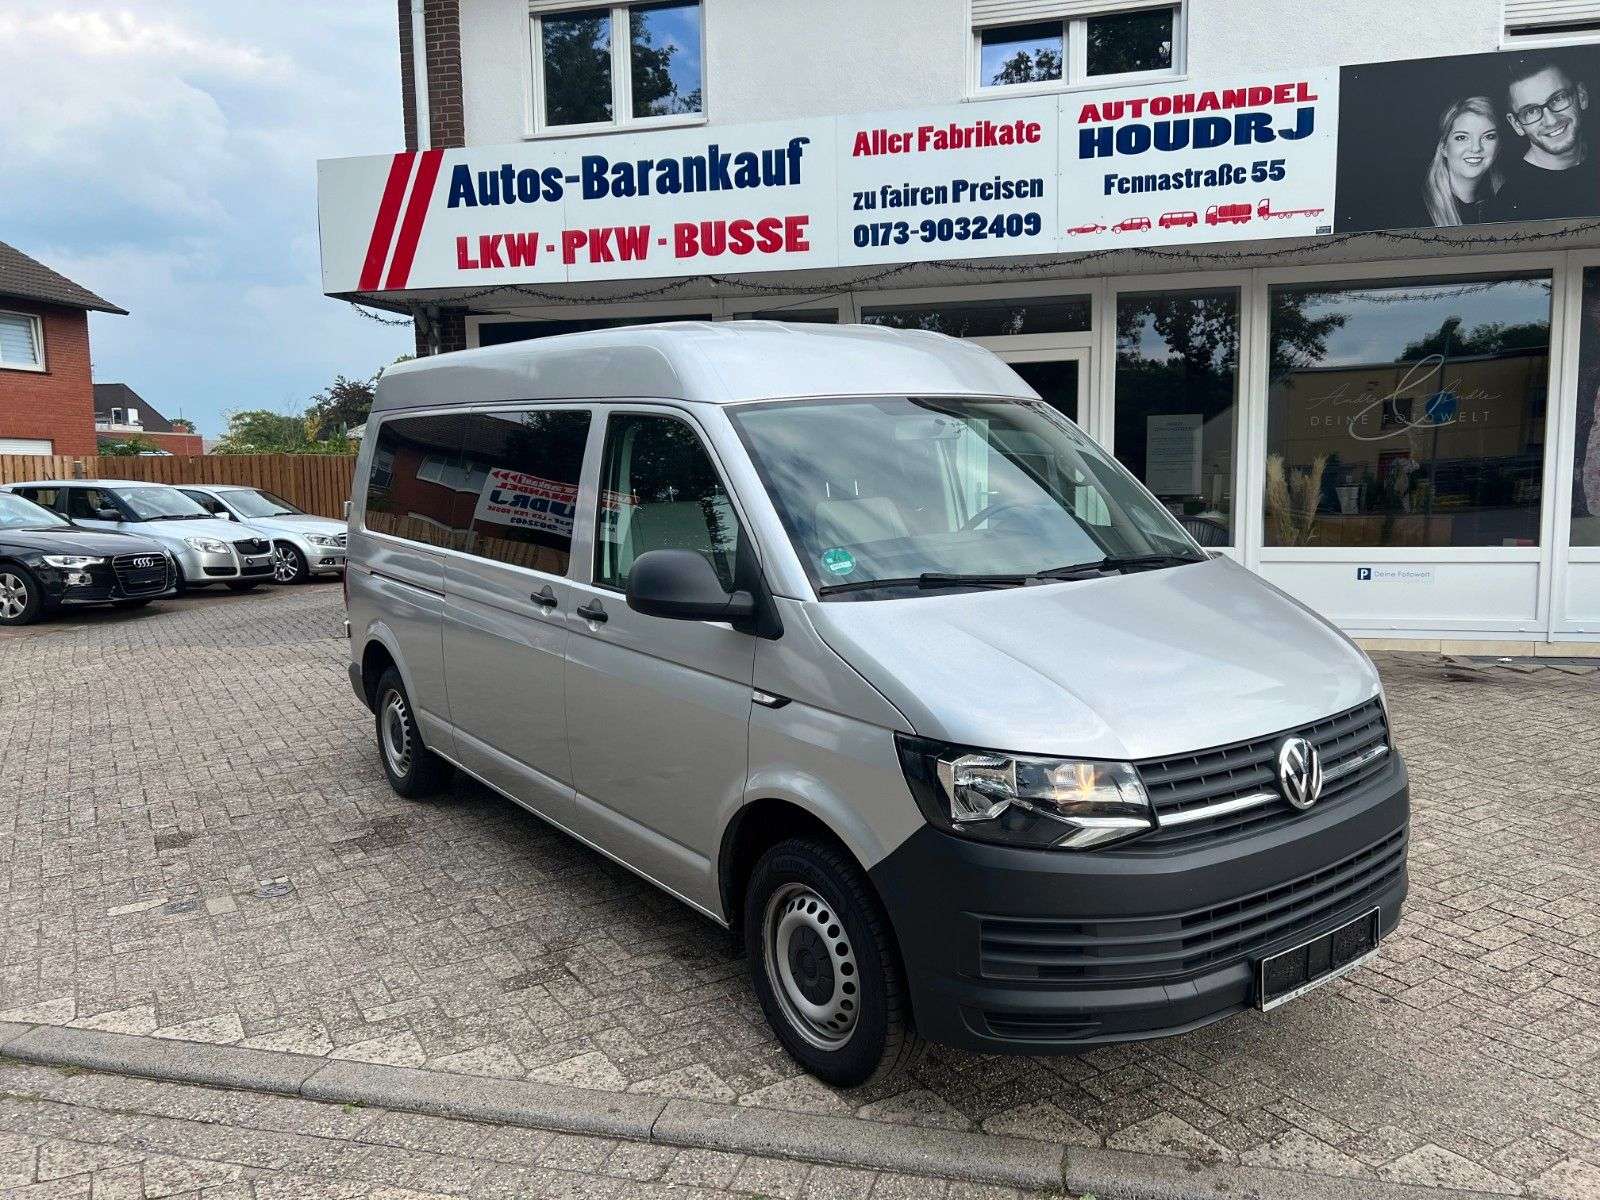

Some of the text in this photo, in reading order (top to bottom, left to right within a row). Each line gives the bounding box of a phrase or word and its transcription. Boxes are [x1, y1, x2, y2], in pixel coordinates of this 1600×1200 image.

[1077, 82, 1317, 123] AUTOHANDEL
[853, 120, 1041, 157] Aller Fabrikate
[1078, 107, 1315, 160] HOUDRJ
[447, 137, 811, 208] Autos-Barankauf
[1104, 159, 1286, 195] Fennastraße 55
[853, 176, 1043, 210] zu fairen Preisen
[457, 215, 810, 270] LKW PKW BUSSE
[853, 212, 1042, 248] 0173-9032409
